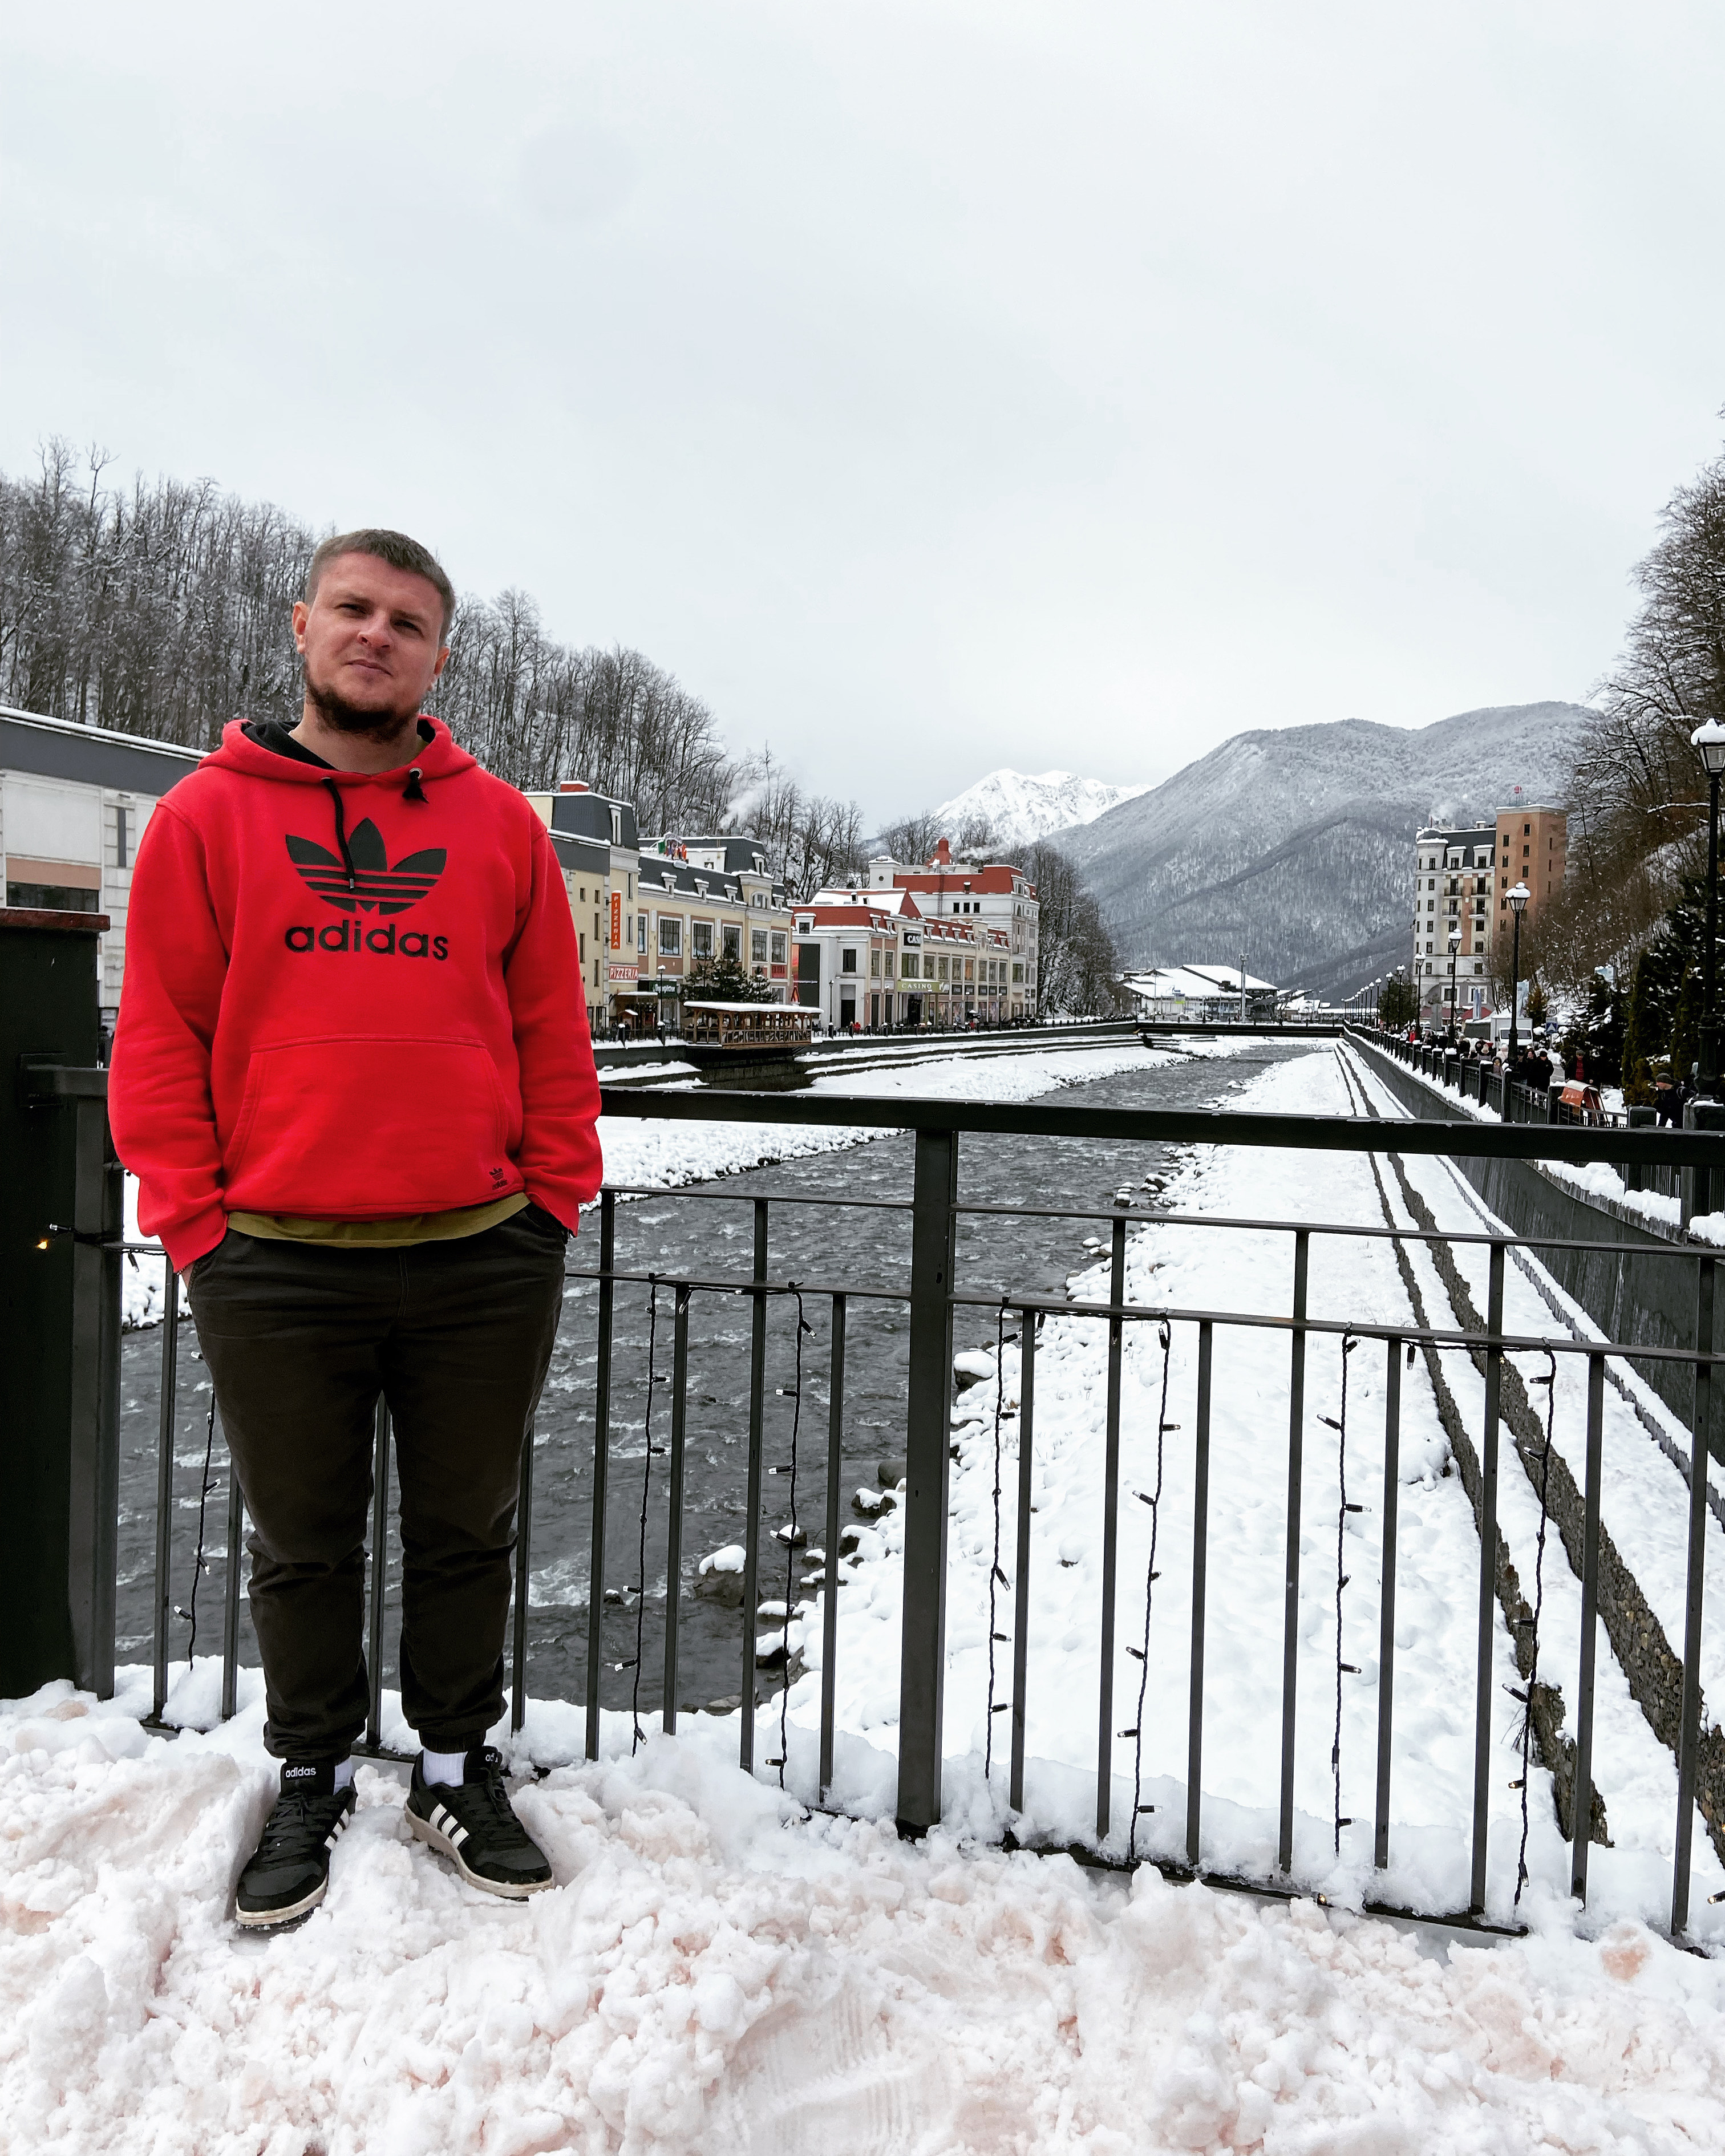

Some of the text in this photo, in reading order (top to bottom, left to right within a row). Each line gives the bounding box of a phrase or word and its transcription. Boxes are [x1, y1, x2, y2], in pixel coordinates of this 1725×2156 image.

[285, 919, 449, 961] adidas
[610, 967, 638, 979] PIZZERIA
[285, 1766, 316, 1778] adidas
